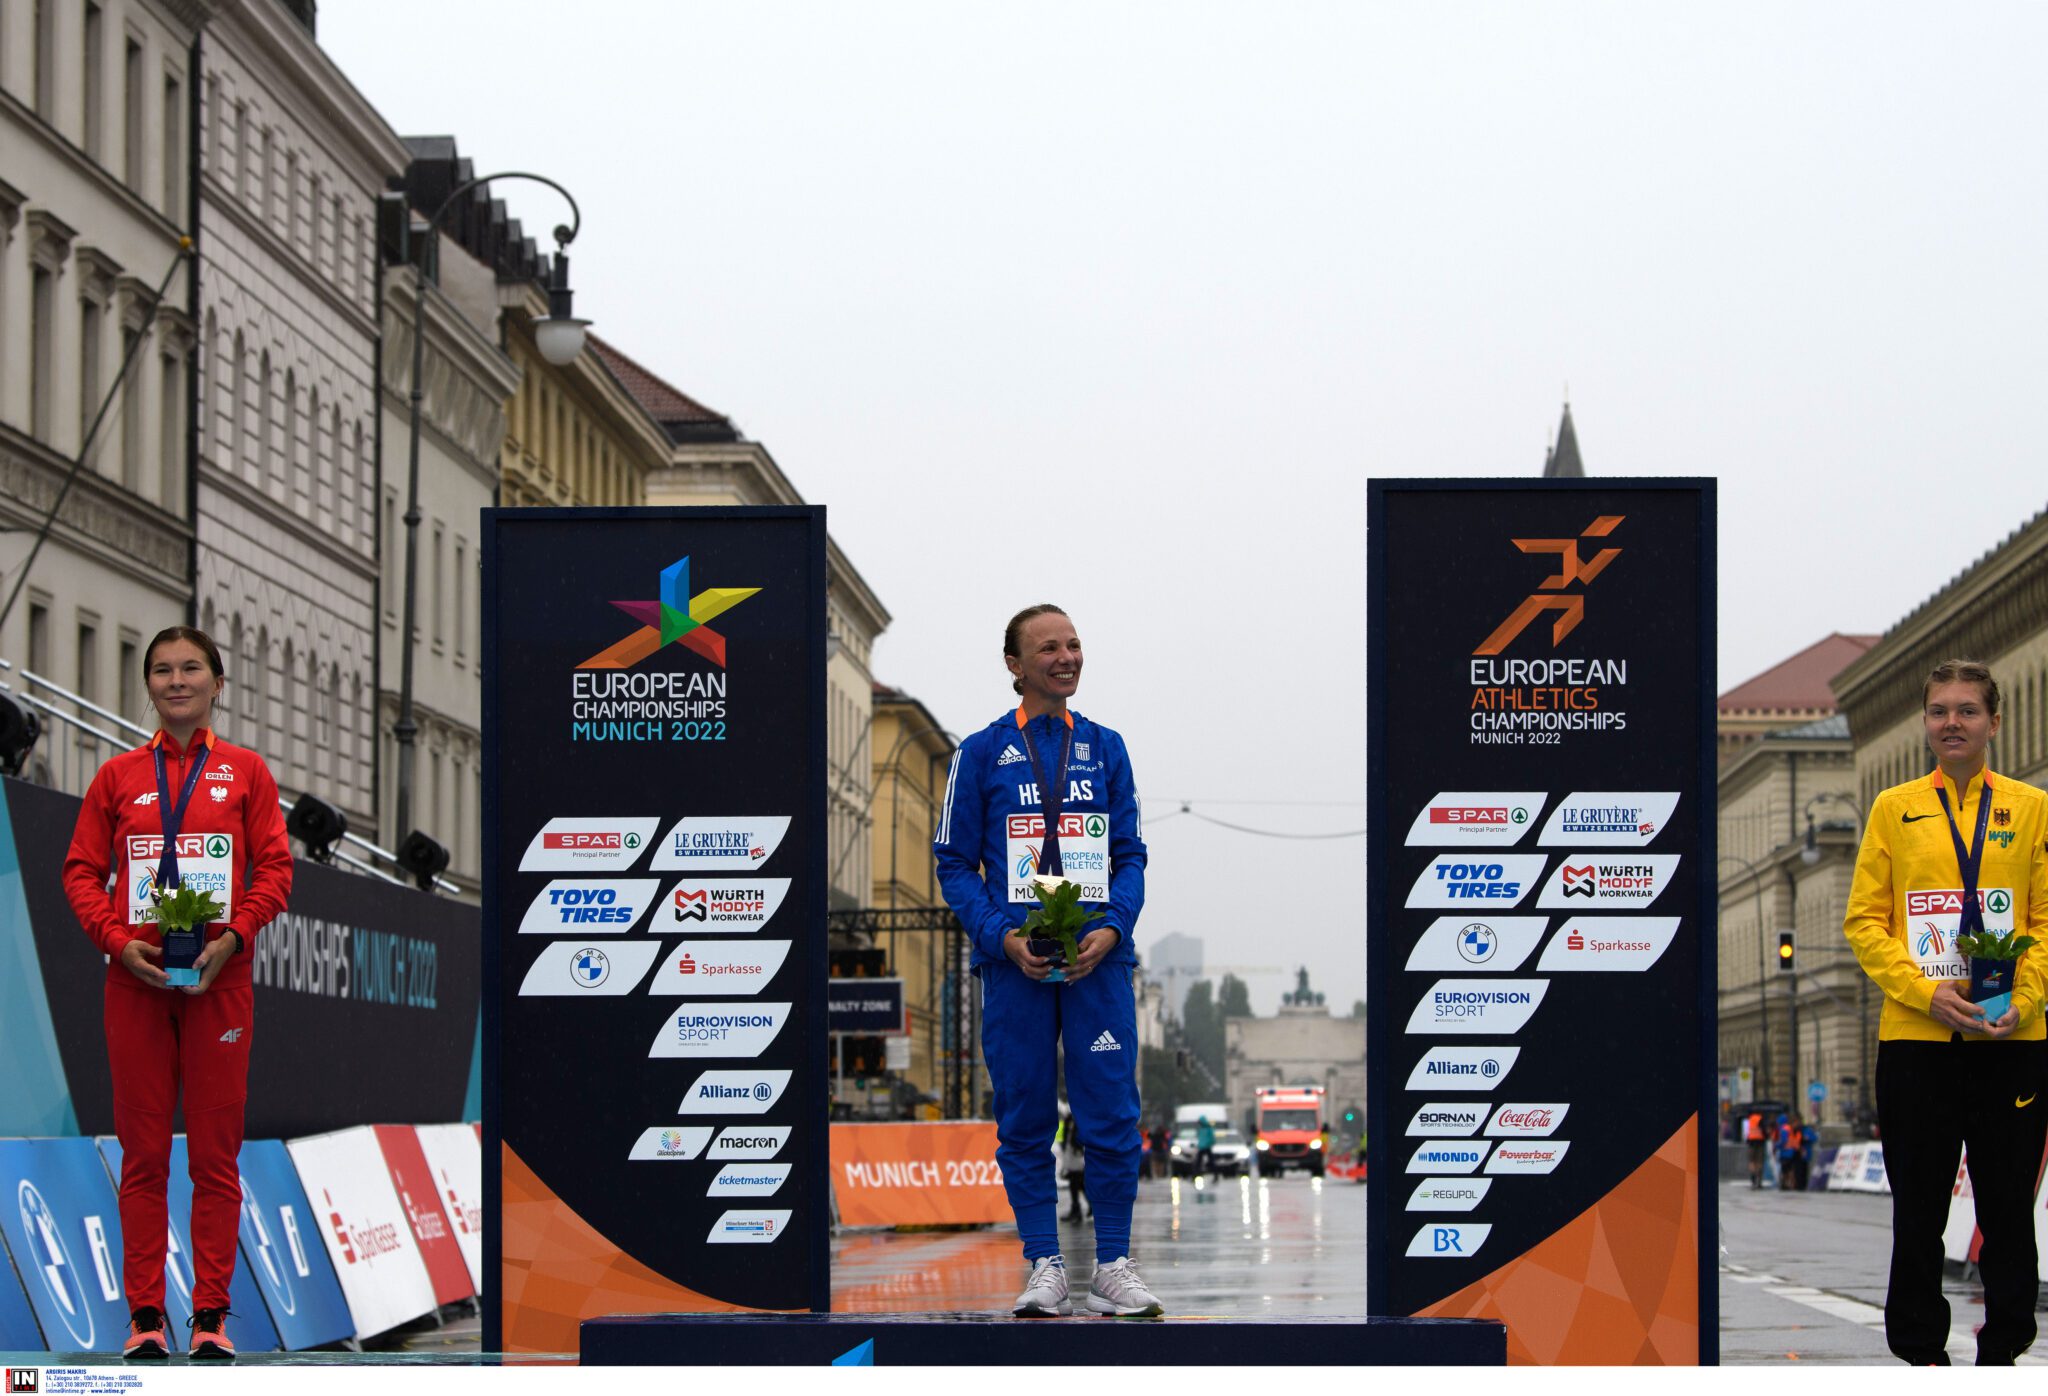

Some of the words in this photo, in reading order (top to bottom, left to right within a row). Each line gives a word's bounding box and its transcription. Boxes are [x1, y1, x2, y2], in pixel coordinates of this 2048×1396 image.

[1471, 659, 1626, 685] EUROPEAN
[573, 673, 726, 698] EUROPEAN
[1471, 688, 1598, 710] ATHLETICS
[573, 701, 726, 719] CHAMPIONSHIPS
[1471, 712, 1626, 730] CHAMPIONSHIPS
[573, 722, 663, 741] MUNICH
[672, 722, 726, 741] 2022
[1471, 732, 1524, 744] MUNICH
[1528, 732, 1561, 744] 2022
[998, 755, 1027, 766] adidas
[134, 793, 159, 806] 4F
[1018, 780, 1094, 806] HEAS
[1448, 810, 1507, 821] SPAR
[1563, 808, 1579, 823] LE
[1581, 806, 1638, 823] GRUYÈRE
[561, 835, 619, 846] SPAR
[675, 833, 688, 847] LE
[692, 830, 749, 848] GRUYÈRE
[1061, 861, 1103, 870] HLETICS
[1436, 864, 1504, 880] TOYO
[185, 882, 226, 890] HLETICS
[1599, 878, 1653, 888] MODYF
[549, 889, 616, 904] TOYO
[1447, 882, 1520, 898] TIRES
[711, 902, 764, 911] MODYF
[560, 907, 633, 923] TIRES
[1462, 925, 1492, 937] BMW
[1590, 940, 1651, 952] Sparkasse
[575, 949, 605, 962] BMW
[353, 927, 406, 1005] MUNICH
[408, 937, 438, 1009] 2022
[702, 963, 762, 976] Sparkasse
[1435, 1005, 1486, 1017] SPORT
[220, 1027, 243, 1043] 4F
[679, 1028, 729, 1041] SPORT
[1090, 1042, 1121, 1052] adidas
[1427, 1061, 1478, 1075] Allianz
[699, 1085, 750, 1099] Allianz
[1418, 1113, 1475, 1123] BORNAN
[720, 1137, 778, 1149] macron
[1428, 1152, 1479, 1162] MONDO
[719, 1175, 778, 1185] ticketmaster
[845, 1162, 941, 1188] MUNICH
[945, 1162, 1003, 1186] 2022
[1433, 1190, 1478, 1199] REGUPOL
[1434, 1228, 1463, 1252] BR
